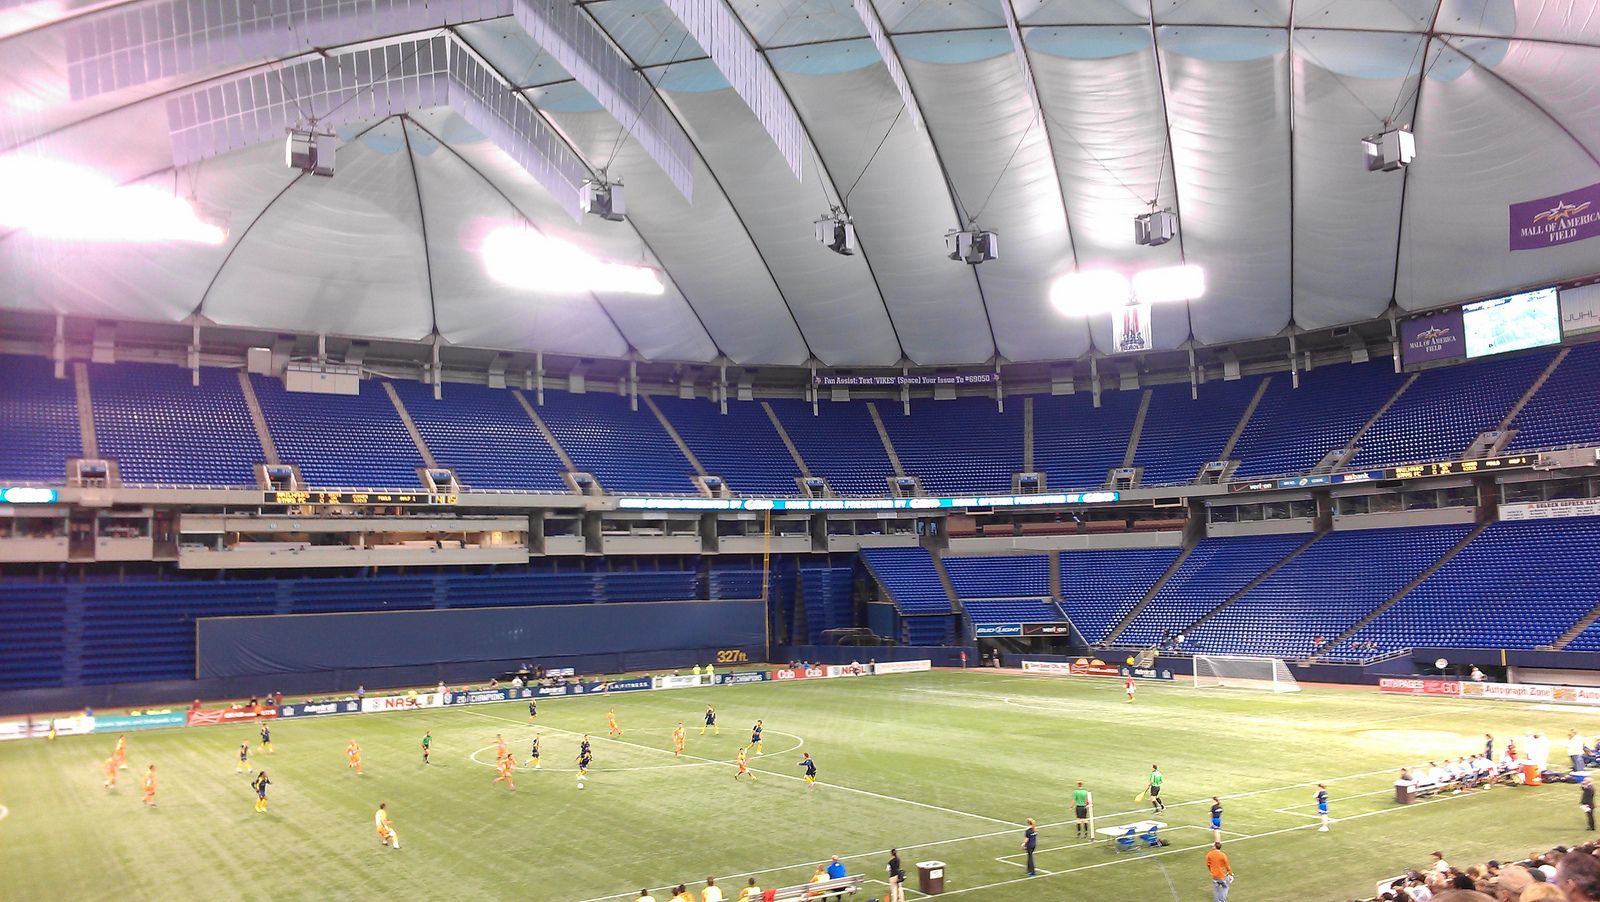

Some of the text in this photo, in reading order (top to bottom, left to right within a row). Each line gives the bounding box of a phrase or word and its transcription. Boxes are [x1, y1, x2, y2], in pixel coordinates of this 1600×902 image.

[1521, 211, 1600, 237] MALL OF AMERICA
[1550, 229, 1577, 242] FIELD
[1564, 310, 1598, 322] JUHL
[1409, 341, 1423, 349] MALL
[1431, 335, 1456, 346] AMERICA
[1426, 345, 1442, 353] FIELD
[921, 376, 936, 384] Your
[937, 376, 955, 384] Issue
[1249, 482, 1272, 491] verizon
[1485, 685, 1551, 697] Autograph Zone
